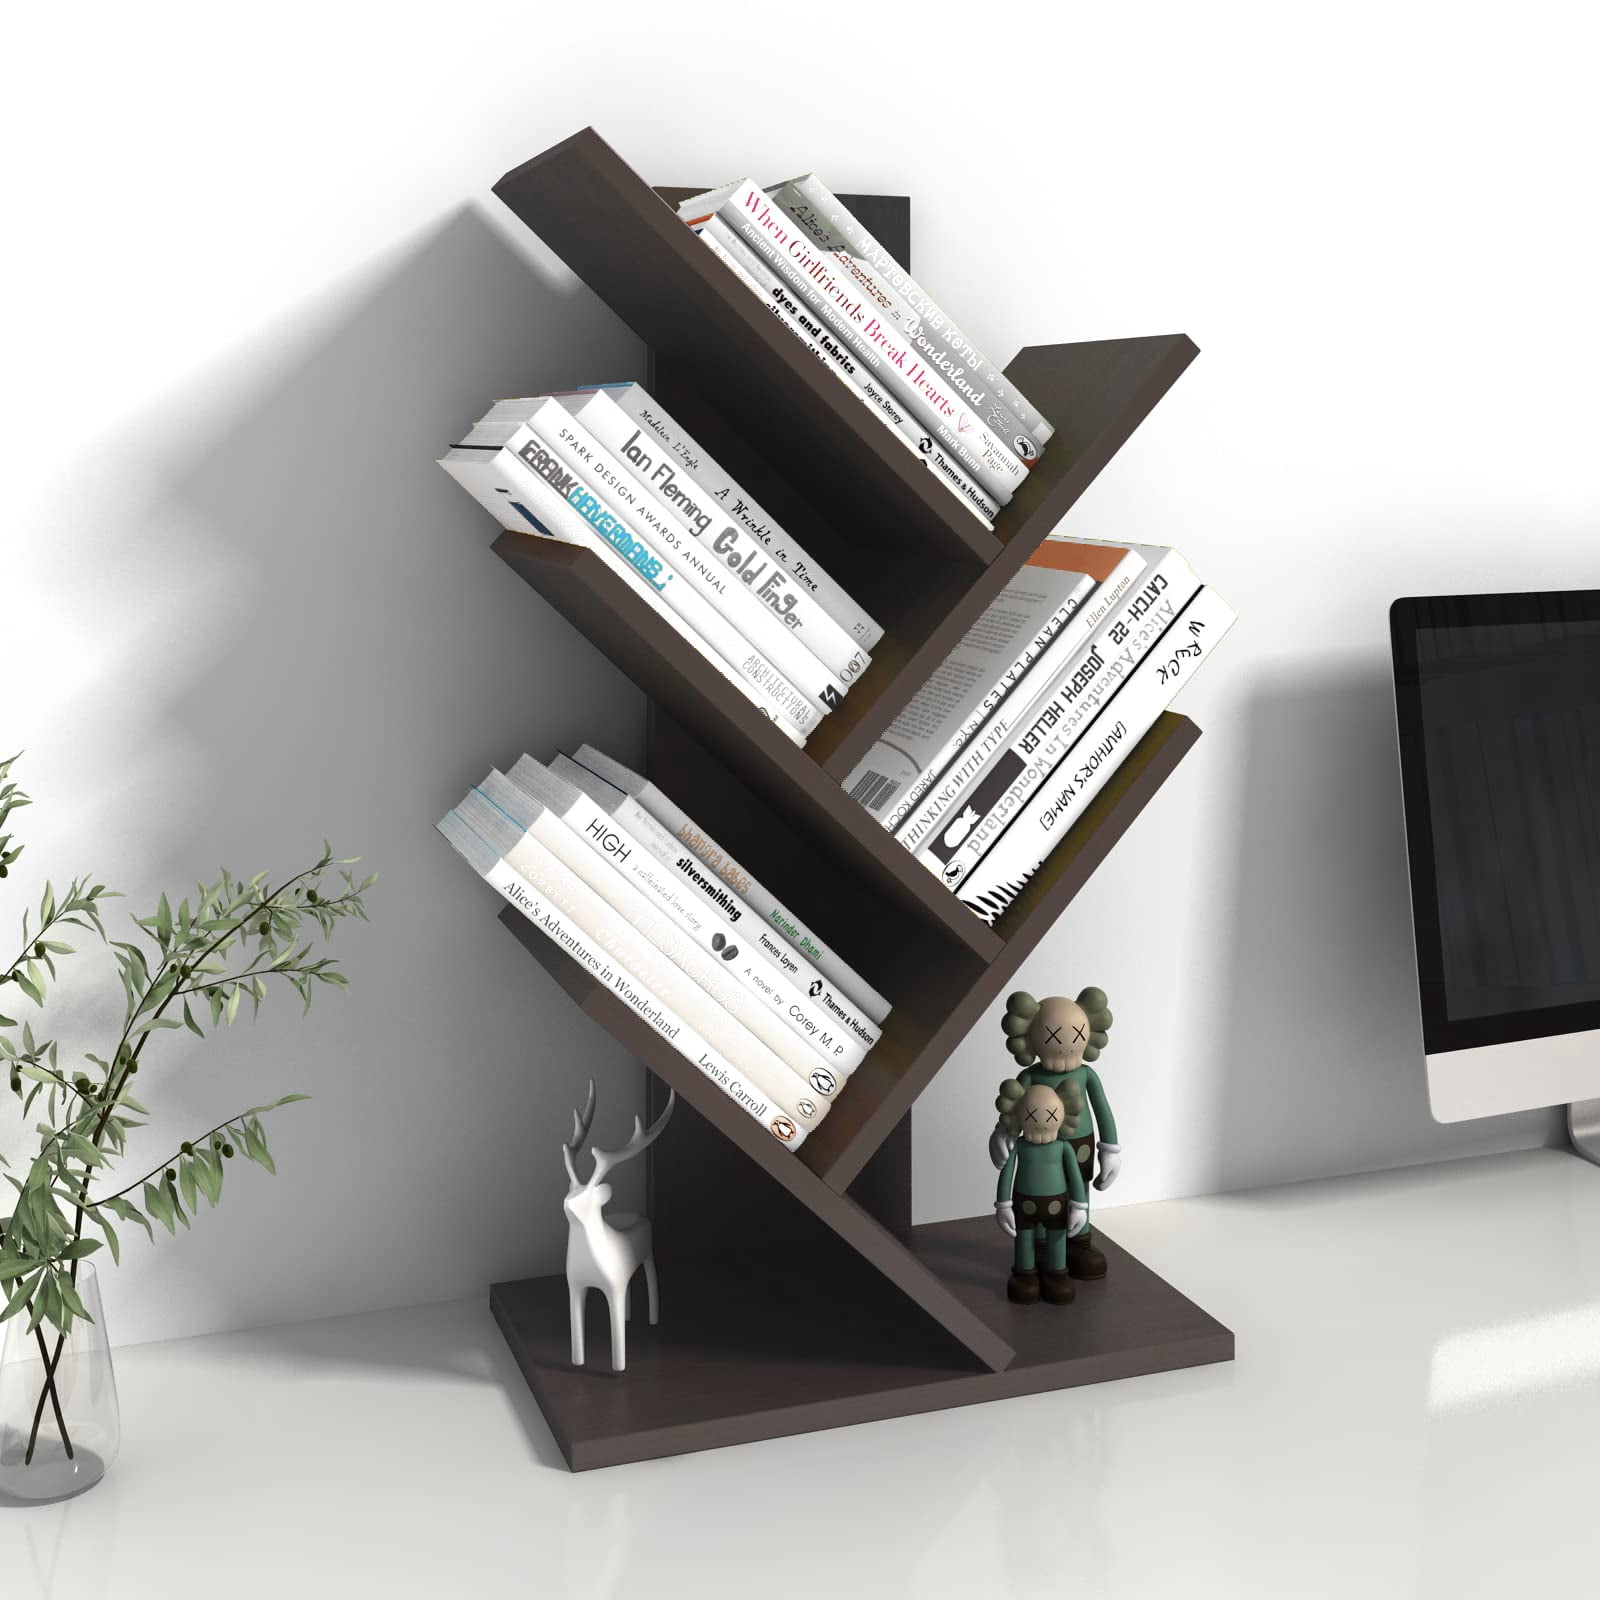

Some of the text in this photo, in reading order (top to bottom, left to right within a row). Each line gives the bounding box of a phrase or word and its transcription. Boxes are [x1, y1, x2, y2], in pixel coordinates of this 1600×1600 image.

[741, 223, 775, 258] Ancient
[774, 253, 808, 292] Wisdom
[806, 289, 823, 305] for
[820, 304, 853, 340] Modern
[852, 337, 881, 368] Health
[745, 191, 788, 244] When
[788, 240, 865, 324] Girlfriends
[863, 318, 907, 369] Break
[906, 363, 955, 417] Hearts
[772, 287, 856, 374] dyes and fabrics
[903, 316, 986, 406] Wonderland
[942, 327, 984, 371] КОТЫ
[864, 383, 903, 424] Joyce Storey
[937, 425, 981, 472] Mark Bunn
[979, 431, 1020, 476] Savannah
[982, 450, 1004, 474] Page
[559, 428, 593, 463] SPARK
[594, 463, 637, 505] DESIGN
[637, 506, 682, 550] AWARDS
[682, 551, 727, 595] ANNUAL
[620, 429, 712, 537] Ian Fleming
[934, 453, 963, 485] Thames
[967, 487, 994, 518] Hudson
[714, 488, 818, 592] A Wrinkle in Time
[713, 526, 803, 629] Gold Finger
[1085, 576, 1131, 629] Ellen Lupton
[1107, 573, 1168, 645] CATCH-22
[1034, 598, 1078, 649] CLEAN
[743, 661, 805, 725] CONSTRUCTIONS
[748, 655, 811, 720] ARCHITECTURAL
[983, 651, 1034, 712] PLATES
[1018, 644, 1105, 754] JOSEPH HELLER
[967, 599, 1175, 857] Alice's Adventures In Wonderland
[887, 769, 937, 832] JARED KOCH
[902, 718, 1009, 850] THINKING WITH TYPE
[585, 818, 632, 863] HIGH
[676, 823, 723, 870] bhangra
[719, 862, 752, 895] babes
[672, 893, 684, 914] love
[676, 857, 742, 922] silversmithing
[503, 882, 542, 917] Alice's
[539, 914, 602, 971] Adventures
[600, 965, 613, 982] in
[614, 976, 681, 1040] Wonderland
[758, 933, 798, 974] Frances Loyen
[770, 909, 825, 961] Narinder Dhami
[744, 968, 784, 1006] A novel by
[822, 992, 847, 1020] Thames
[850, 1018, 874, 1046] Hudson
[789, 1005, 844, 1056] Corey M. P.
[698, 1053, 768, 1117] Lewis Carroll
